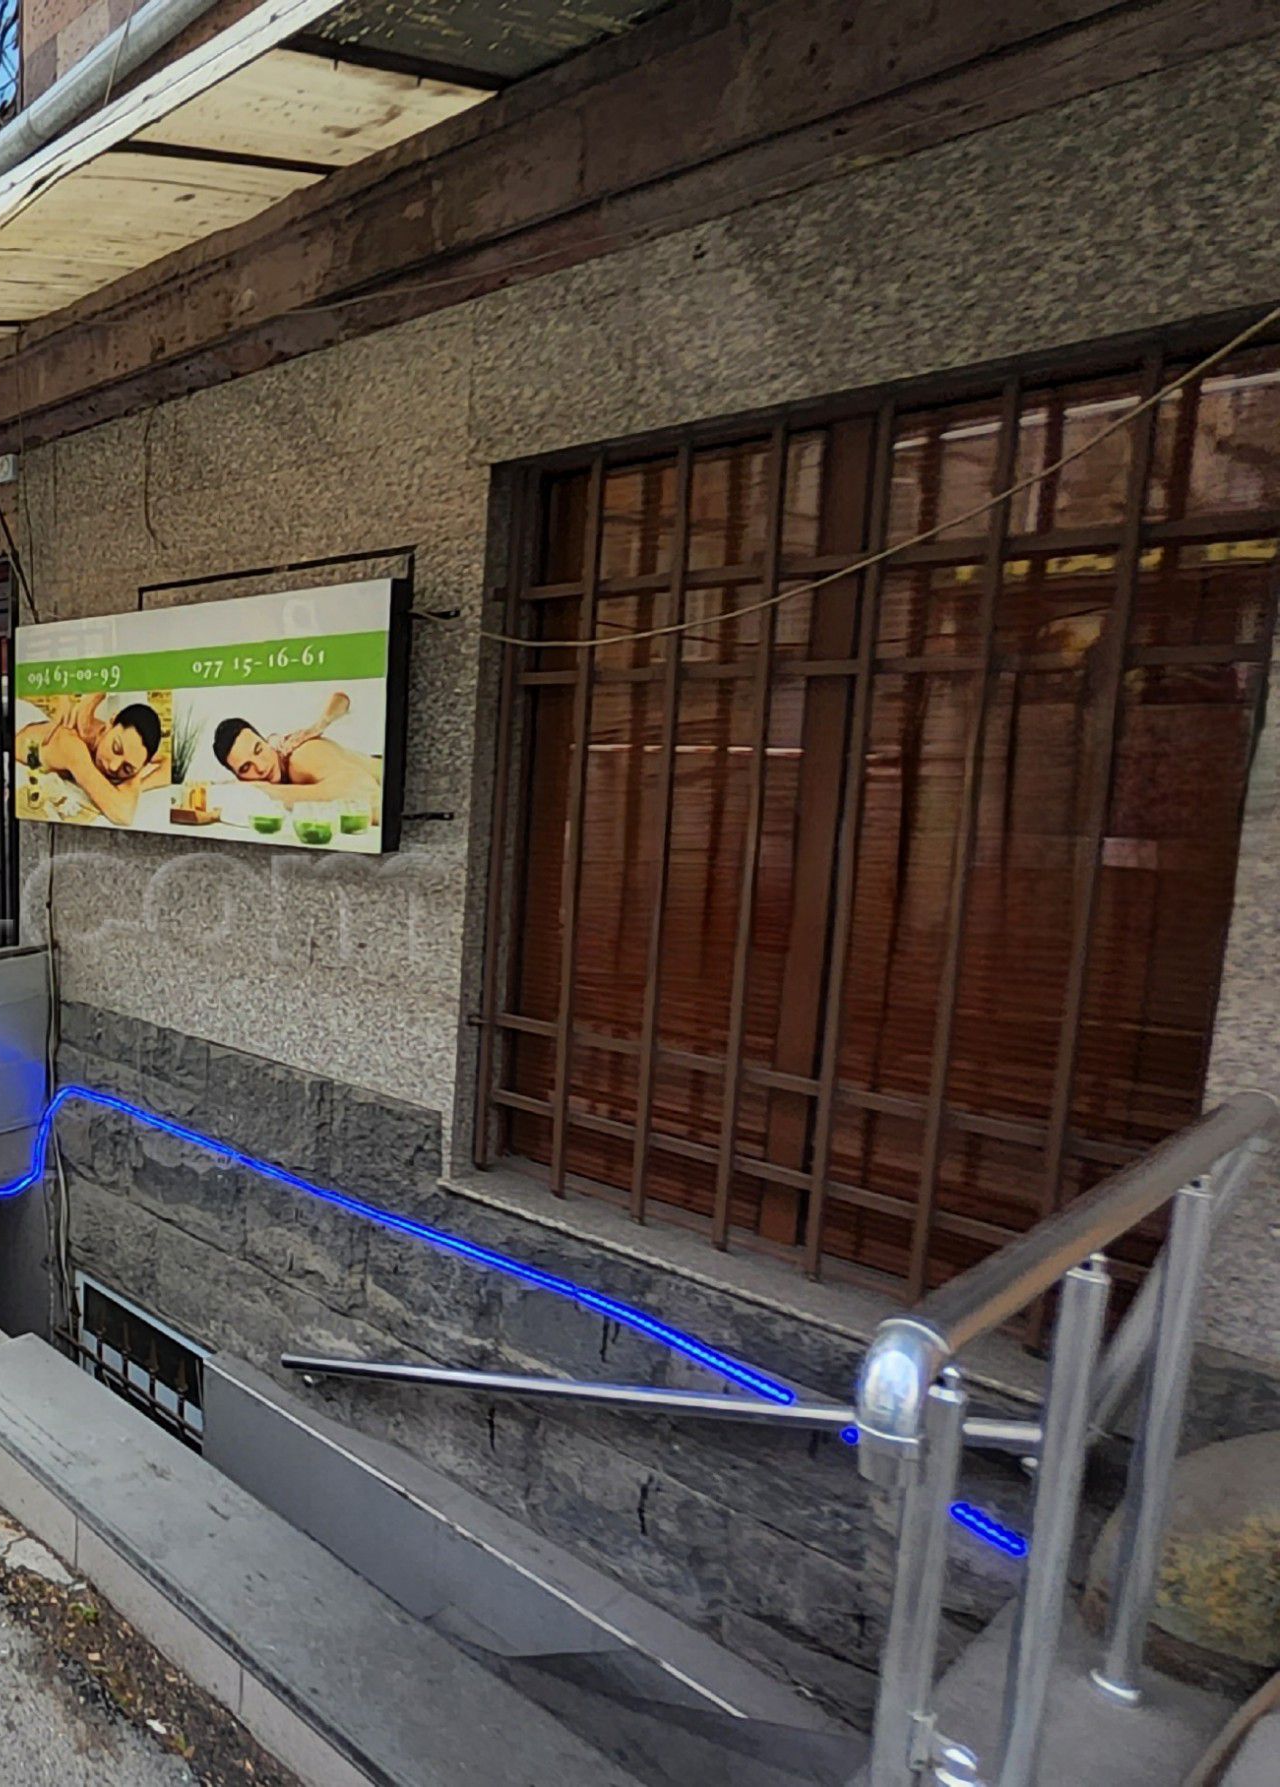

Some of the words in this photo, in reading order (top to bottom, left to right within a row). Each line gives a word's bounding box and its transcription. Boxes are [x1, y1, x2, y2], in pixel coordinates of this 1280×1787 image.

[54, 664, 121, 688] 63-00-99
[191, 659, 224, 679] 077
[232, 644, 325, 678] 15-16-61
